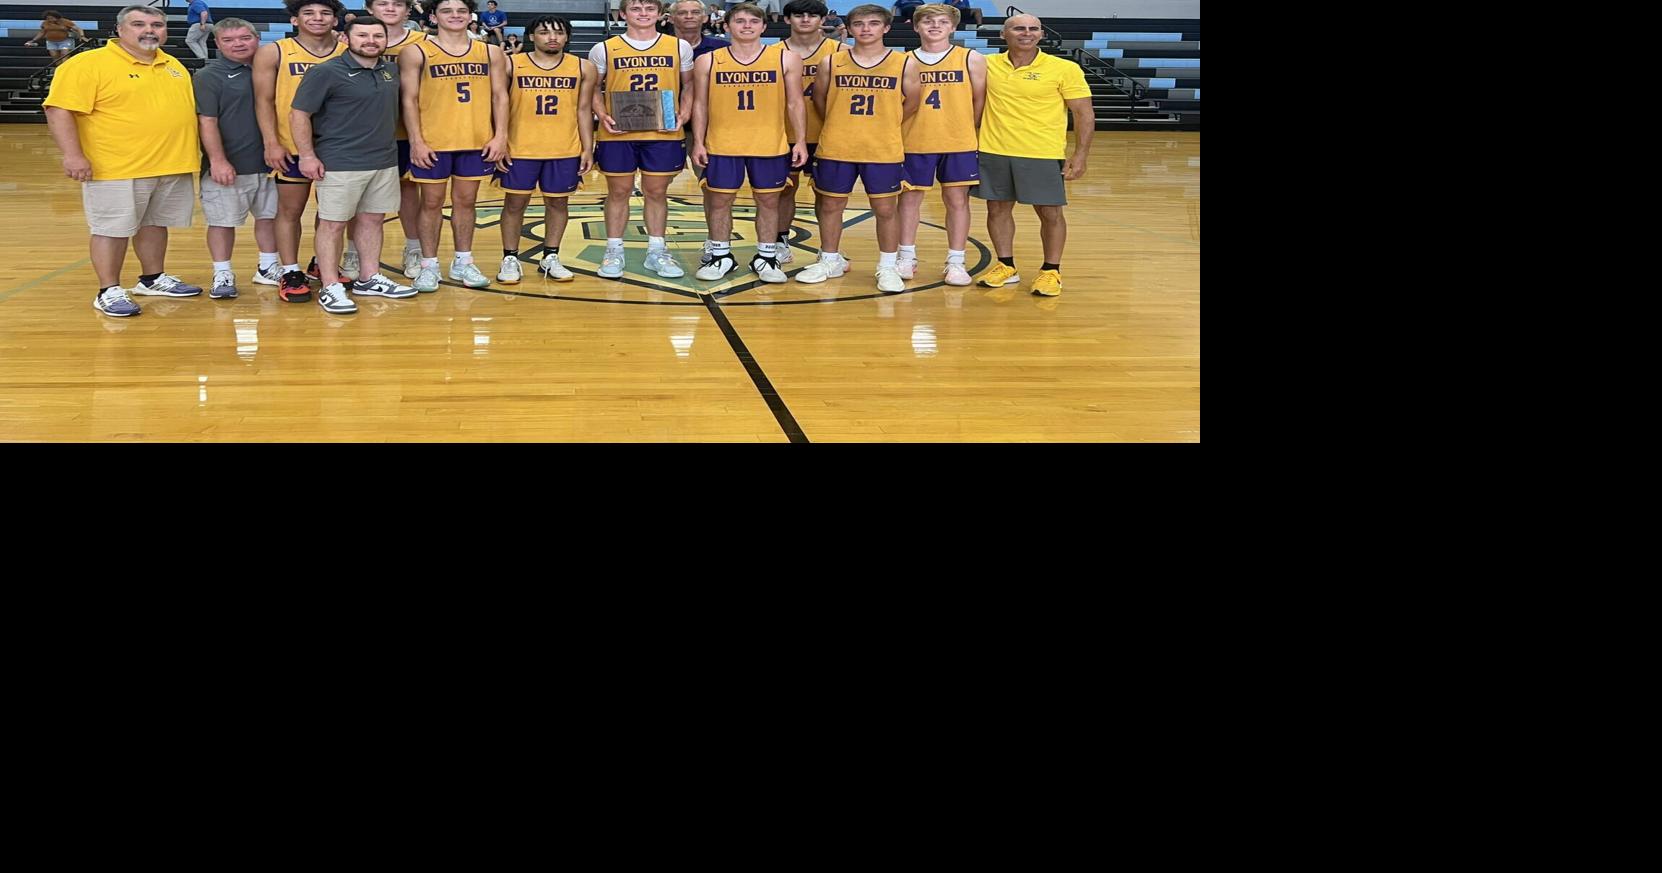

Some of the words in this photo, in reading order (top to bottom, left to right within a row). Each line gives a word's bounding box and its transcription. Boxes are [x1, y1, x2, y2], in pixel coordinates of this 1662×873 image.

[434, 64, 465, 76] LYON
[468, 63, 485, 75] CO.
[618, 57, 647, 68] LYON
[651, 56, 669, 67] CO.
[521, 77, 551, 88] LYON
[555, 77, 572, 88] CO.
[630, 74, 658, 92] 22
[720, 72, 749, 83] LYON
[753, 71, 771, 82] CO.
[840, 76, 868, 87] LYON
[872, 77, 891, 88] CO.
[940, 71, 958, 82] CO.
[456, 82, 471, 103] 5
[737, 90, 754, 110] 11
[925, 90, 941, 109] 4
[536, 95, 558, 115] 12
[850, 94, 875, 115] 21
